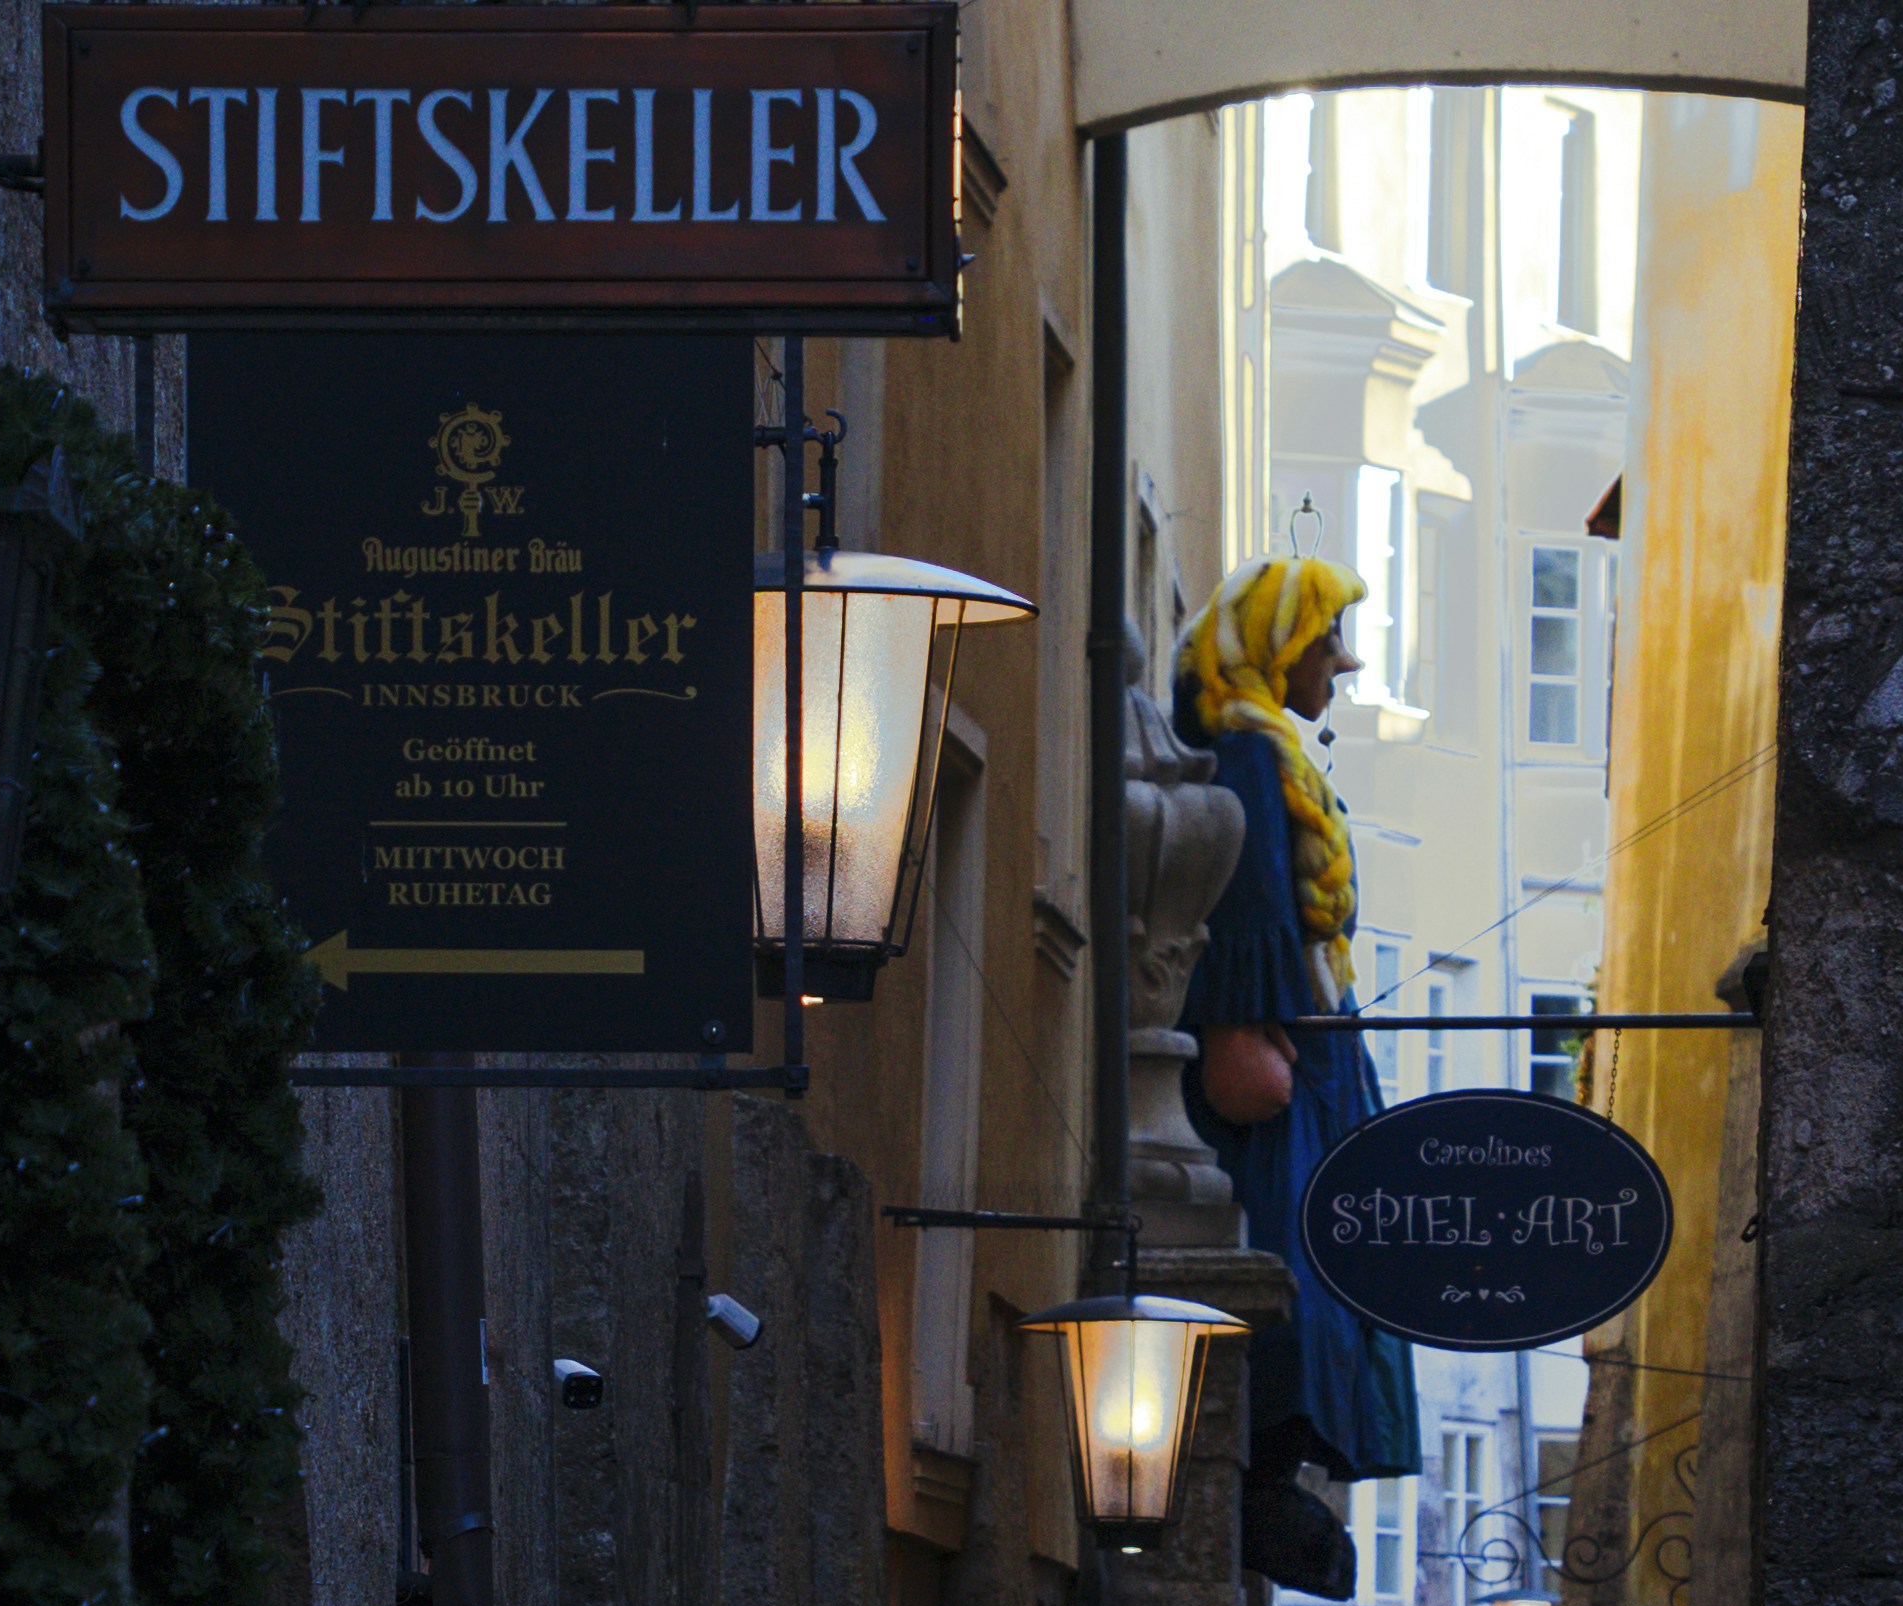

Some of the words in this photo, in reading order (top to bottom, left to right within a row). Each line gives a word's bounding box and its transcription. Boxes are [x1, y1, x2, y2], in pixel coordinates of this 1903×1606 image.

[118, 86, 887, 224] STIFTSKELLER
[362, 536, 520, 578] Augustiner
[528, 536, 583, 573] Bräu
[260, 585, 698, 665] Stiftskeller
[361, 683, 584, 707] INNSBRUCK
[402, 737, 537, 763] Geöffnet
[395, 774, 432, 799] ab
[441, 778, 476, 799] 10
[484, 774, 545, 799] Uhr
[373, 845, 566, 871] MITTWOCH
[387, 881, 553, 907] RUHETAG
[1419, 1135, 1553, 1168] Carolines
